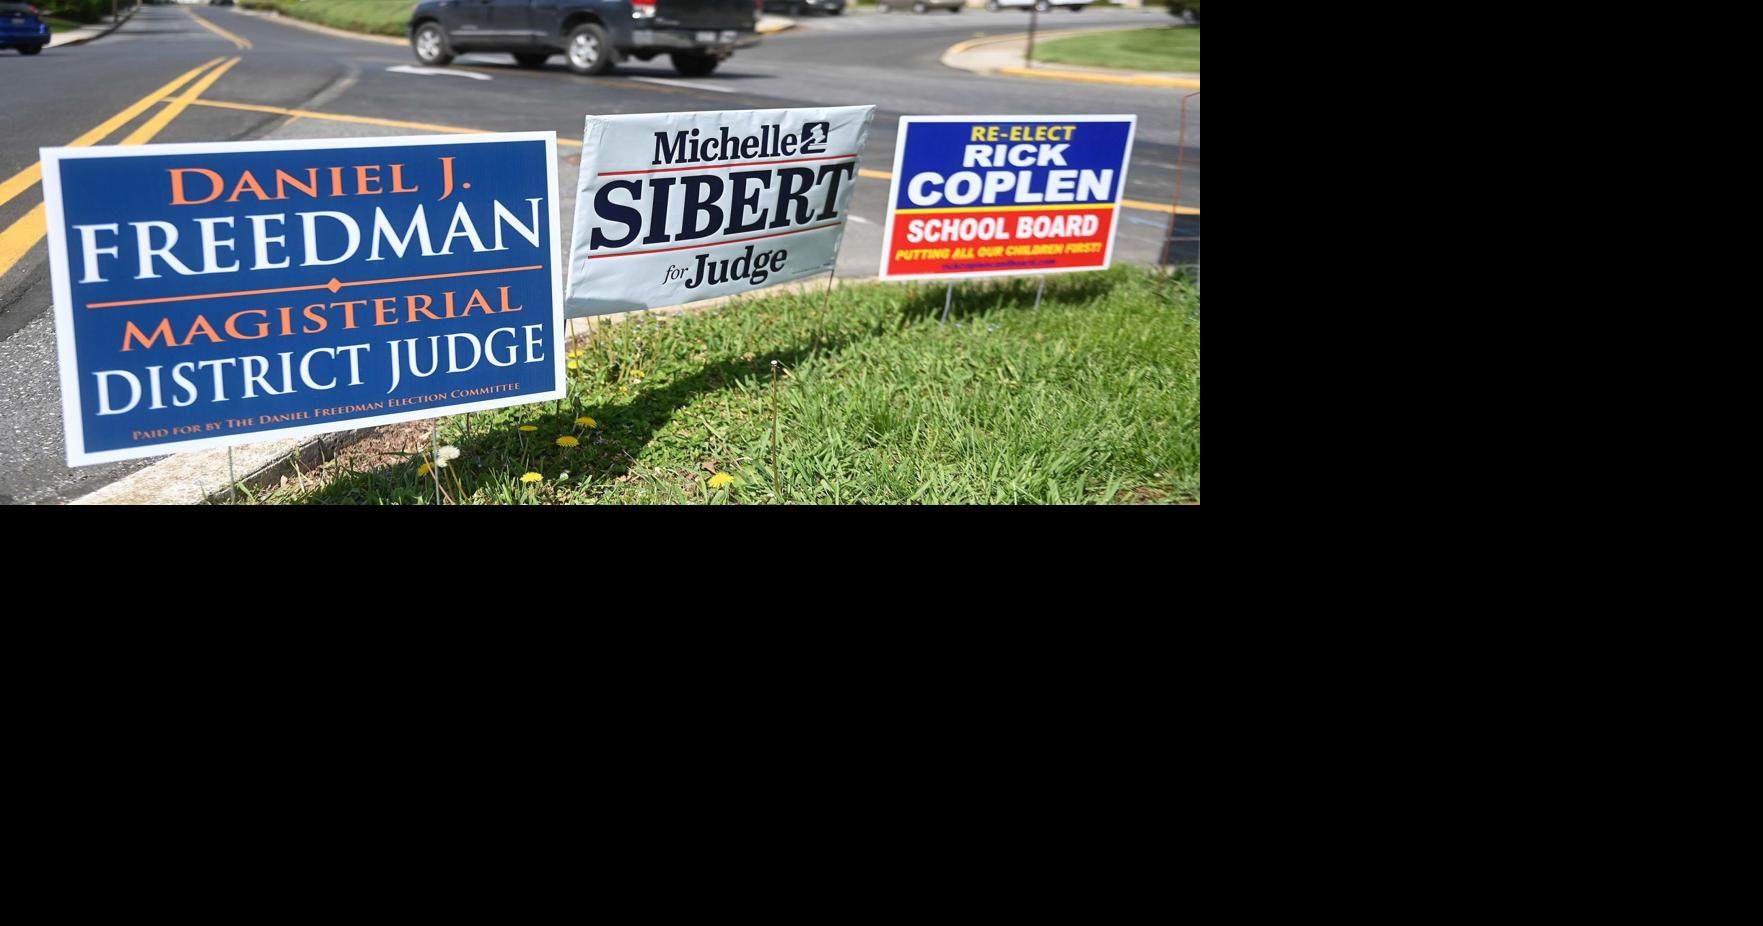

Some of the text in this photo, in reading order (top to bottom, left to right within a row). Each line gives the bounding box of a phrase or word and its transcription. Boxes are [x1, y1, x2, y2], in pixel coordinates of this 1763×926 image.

[652, 124, 797, 165] Michelle
[963, 144, 1071, 168] RICK
[971, 126, 1076, 142] RE-ELECT
[165, 156, 472, 206] DANIEL J.
[907, 169, 1114, 206] COPLEN
[590, 161, 855, 250] SIBERT
[72, 198, 543, 284] FREEDMAN
[906, 214, 1099, 243] SCHOOL BOARD
[662, 245, 788, 289] for Judge
[895, 247, 950, 260] PUTTING
[952, 247, 974, 260] ALL
[977, 245, 1005, 258] OUR
[1006, 243, 1063, 256] CHILDREN
[119, 286, 523, 352] MAGISTERIAL
[91, 323, 545, 416] DISTRICT JUDGE
[132, 429, 169, 440] PAID
[206, 421, 222, 431] BY
[226, 418, 255, 428] THE
[259, 411, 310, 425] DANIEL
[314, 401, 384, 417] FREEDMAN
[388, 392, 447, 408] ELECTION
[451, 382, 521, 399] COMMITTEE
